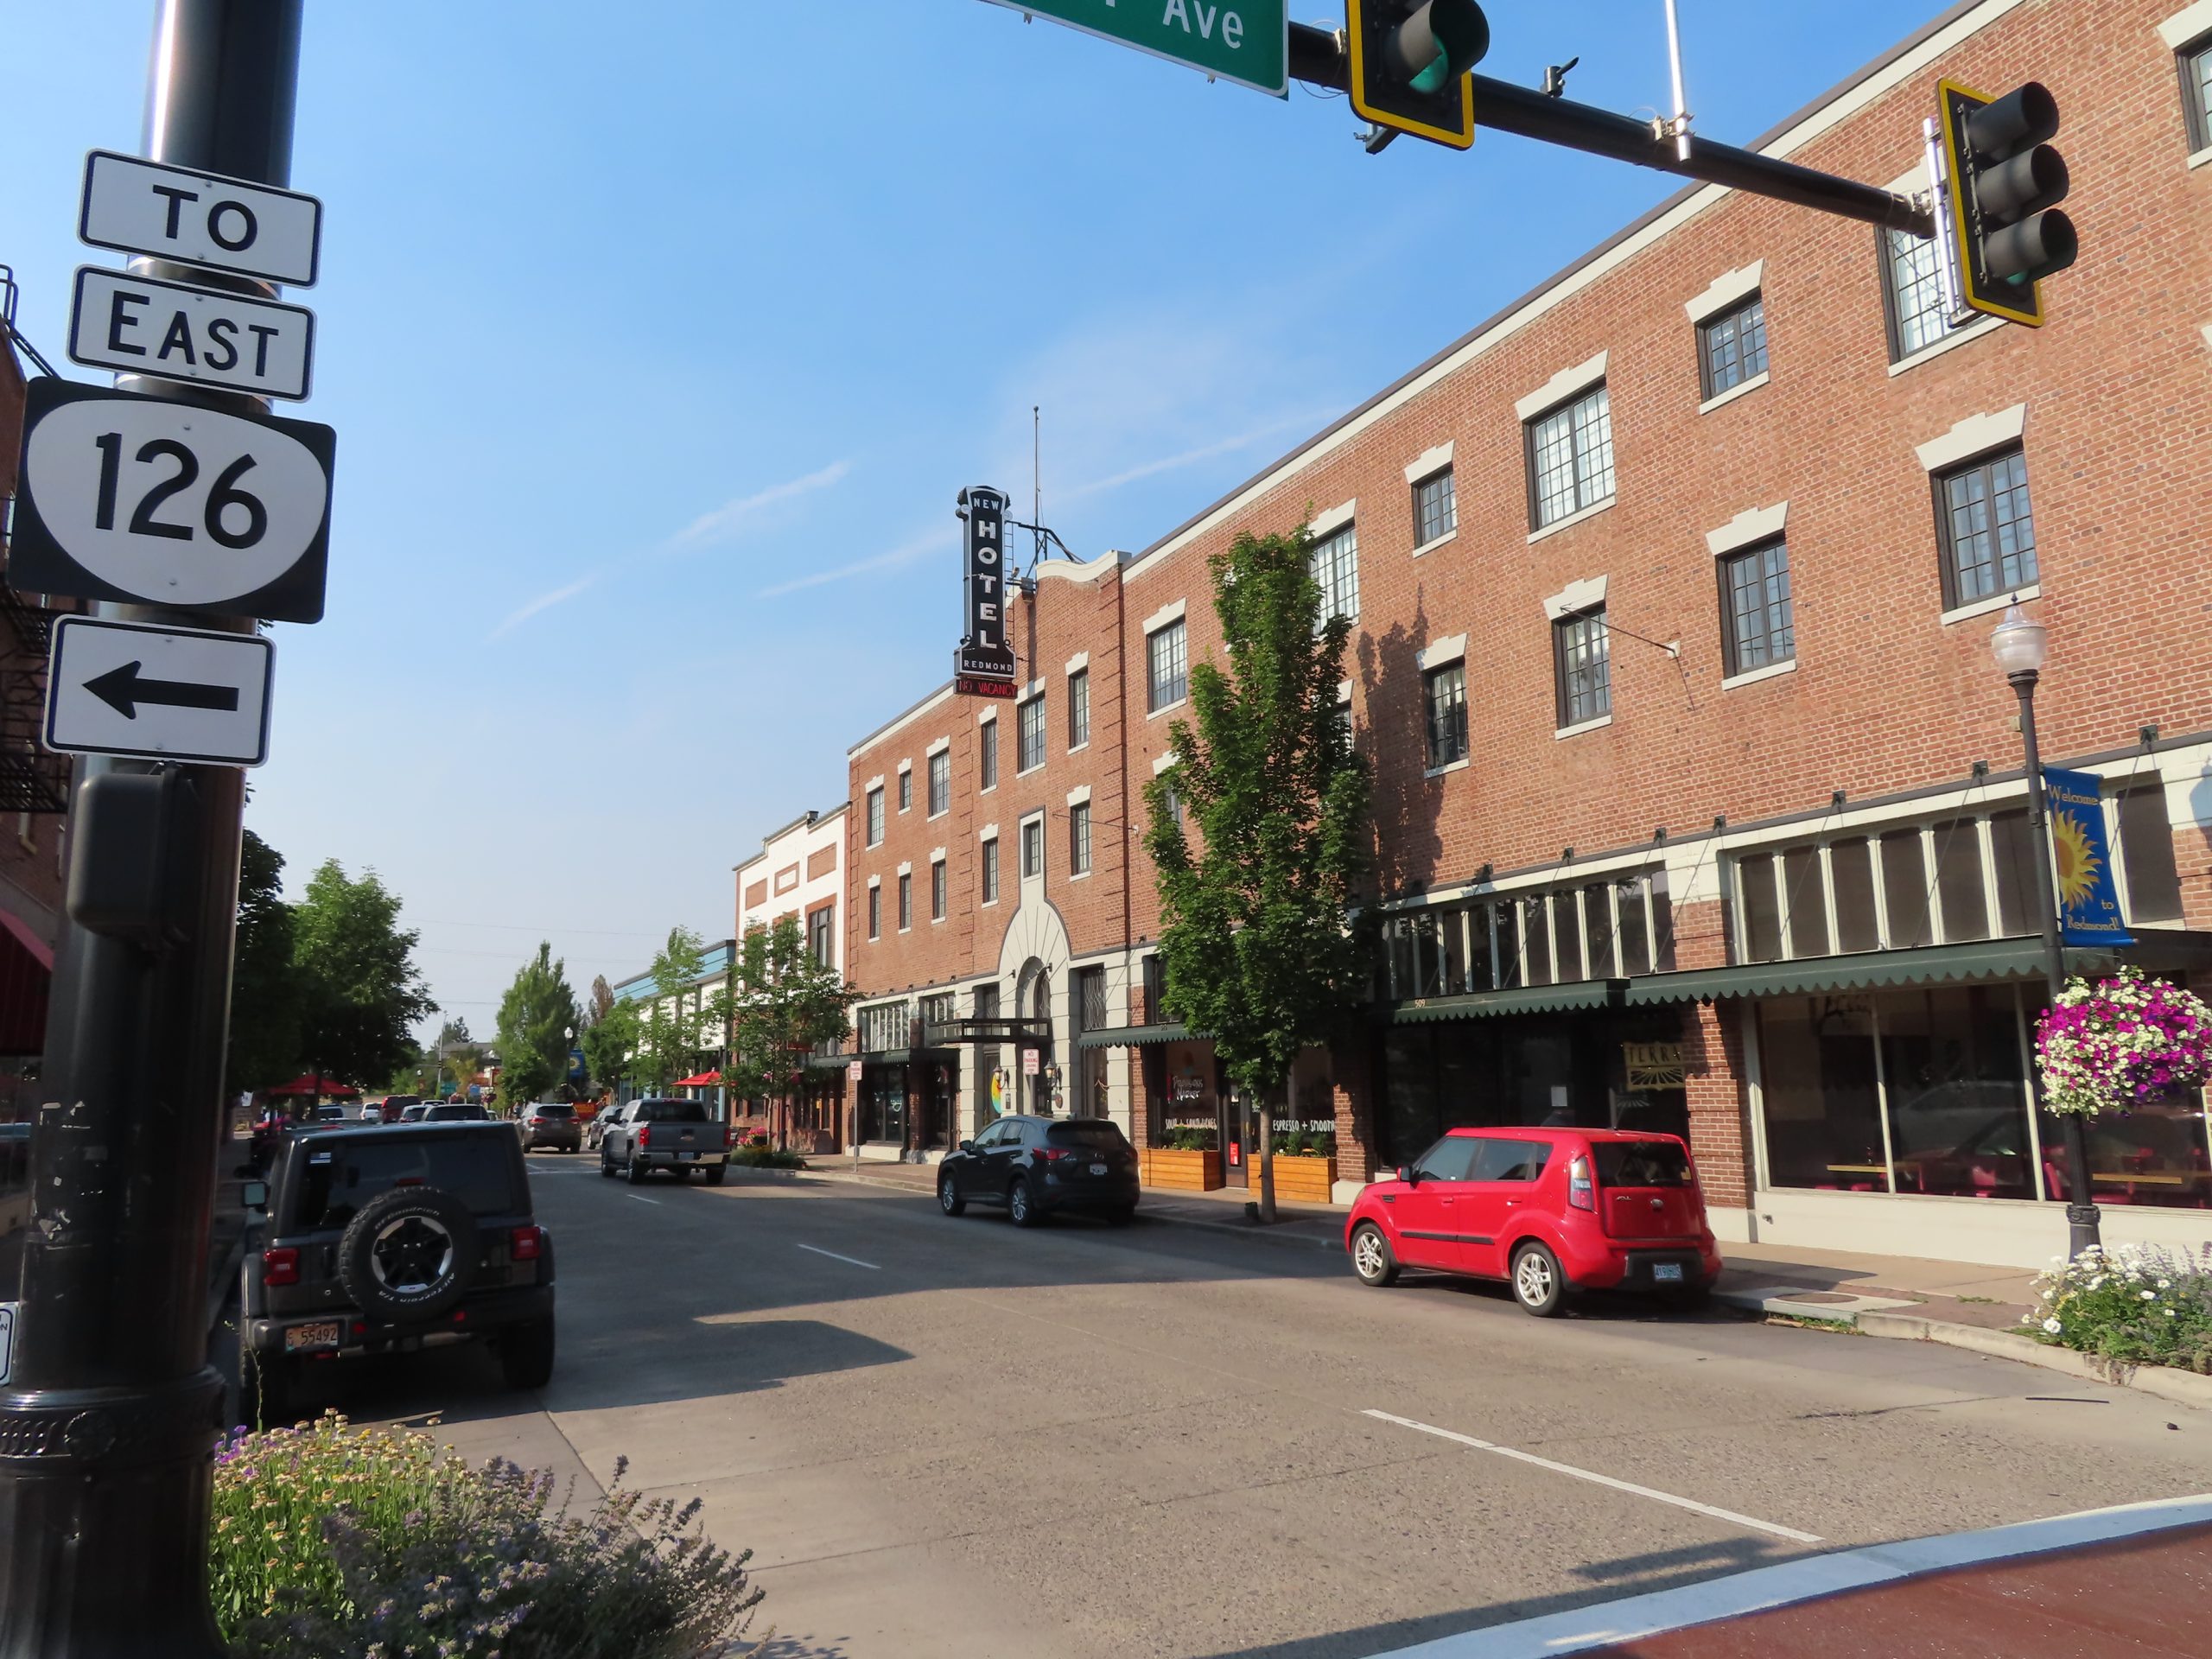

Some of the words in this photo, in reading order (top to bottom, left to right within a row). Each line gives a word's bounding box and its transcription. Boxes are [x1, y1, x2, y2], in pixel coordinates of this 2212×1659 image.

[1162, 0, 1243, 49] Ave
[152, 183, 258, 251] TO
[108, 290, 279, 377] EAST
[95, 432, 267, 550] 126
[973, 497, 999, 511] NEW
[977, 519, 997, 649] HOTEL
[963, 659, 1013, 672] REDMOND
[959, 679, 973, 692] NO
[978, 682, 1018, 696] VACANCY
[2048, 784, 2099, 806] Welcome
[2101, 899, 2114, 910] to
[2066, 914, 2120, 931] Redmond!
[1414, 999, 1426, 1008] 509
[1629, 1046, 1681, 1064] TERRA
[1273, 1120, 1300, 1132] ESPRESSO
[1302, 1121, 1308, 1130] +
[301, 1327, 337, 1345] 55492
